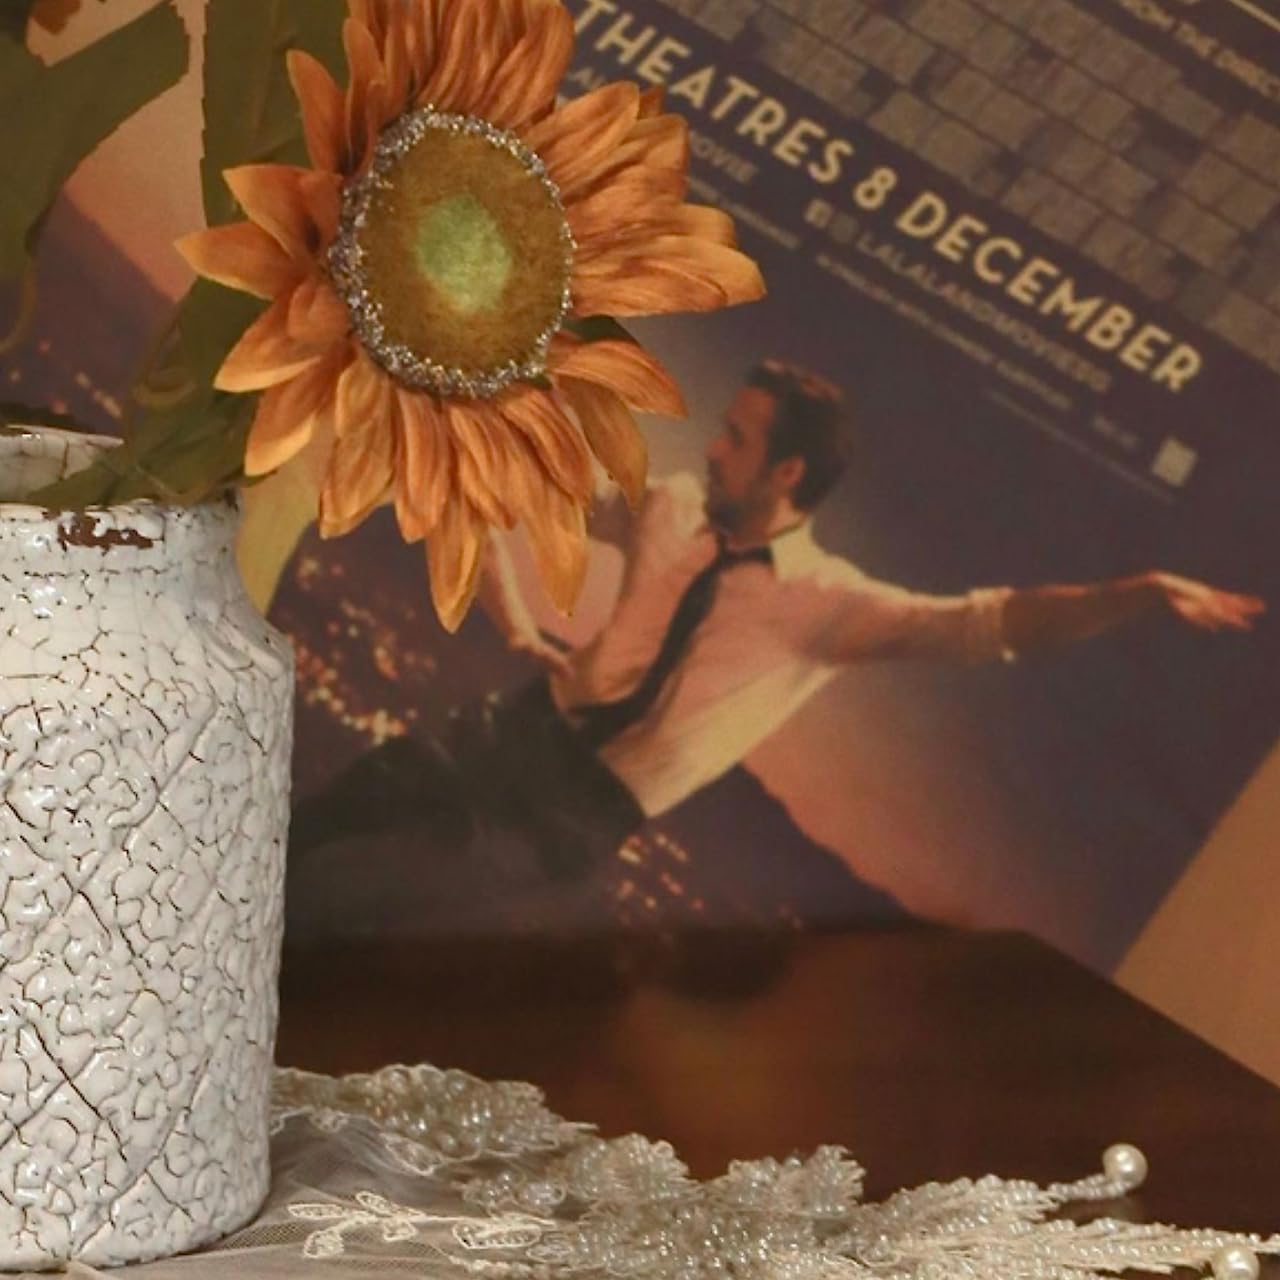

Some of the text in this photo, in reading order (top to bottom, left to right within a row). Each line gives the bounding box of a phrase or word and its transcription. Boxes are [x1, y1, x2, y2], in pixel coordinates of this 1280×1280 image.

[574, 0, 855, 186] THEATRES
[854, 167, 897, 210] 8
[896, 191, 1203, 393] DECEMBER
